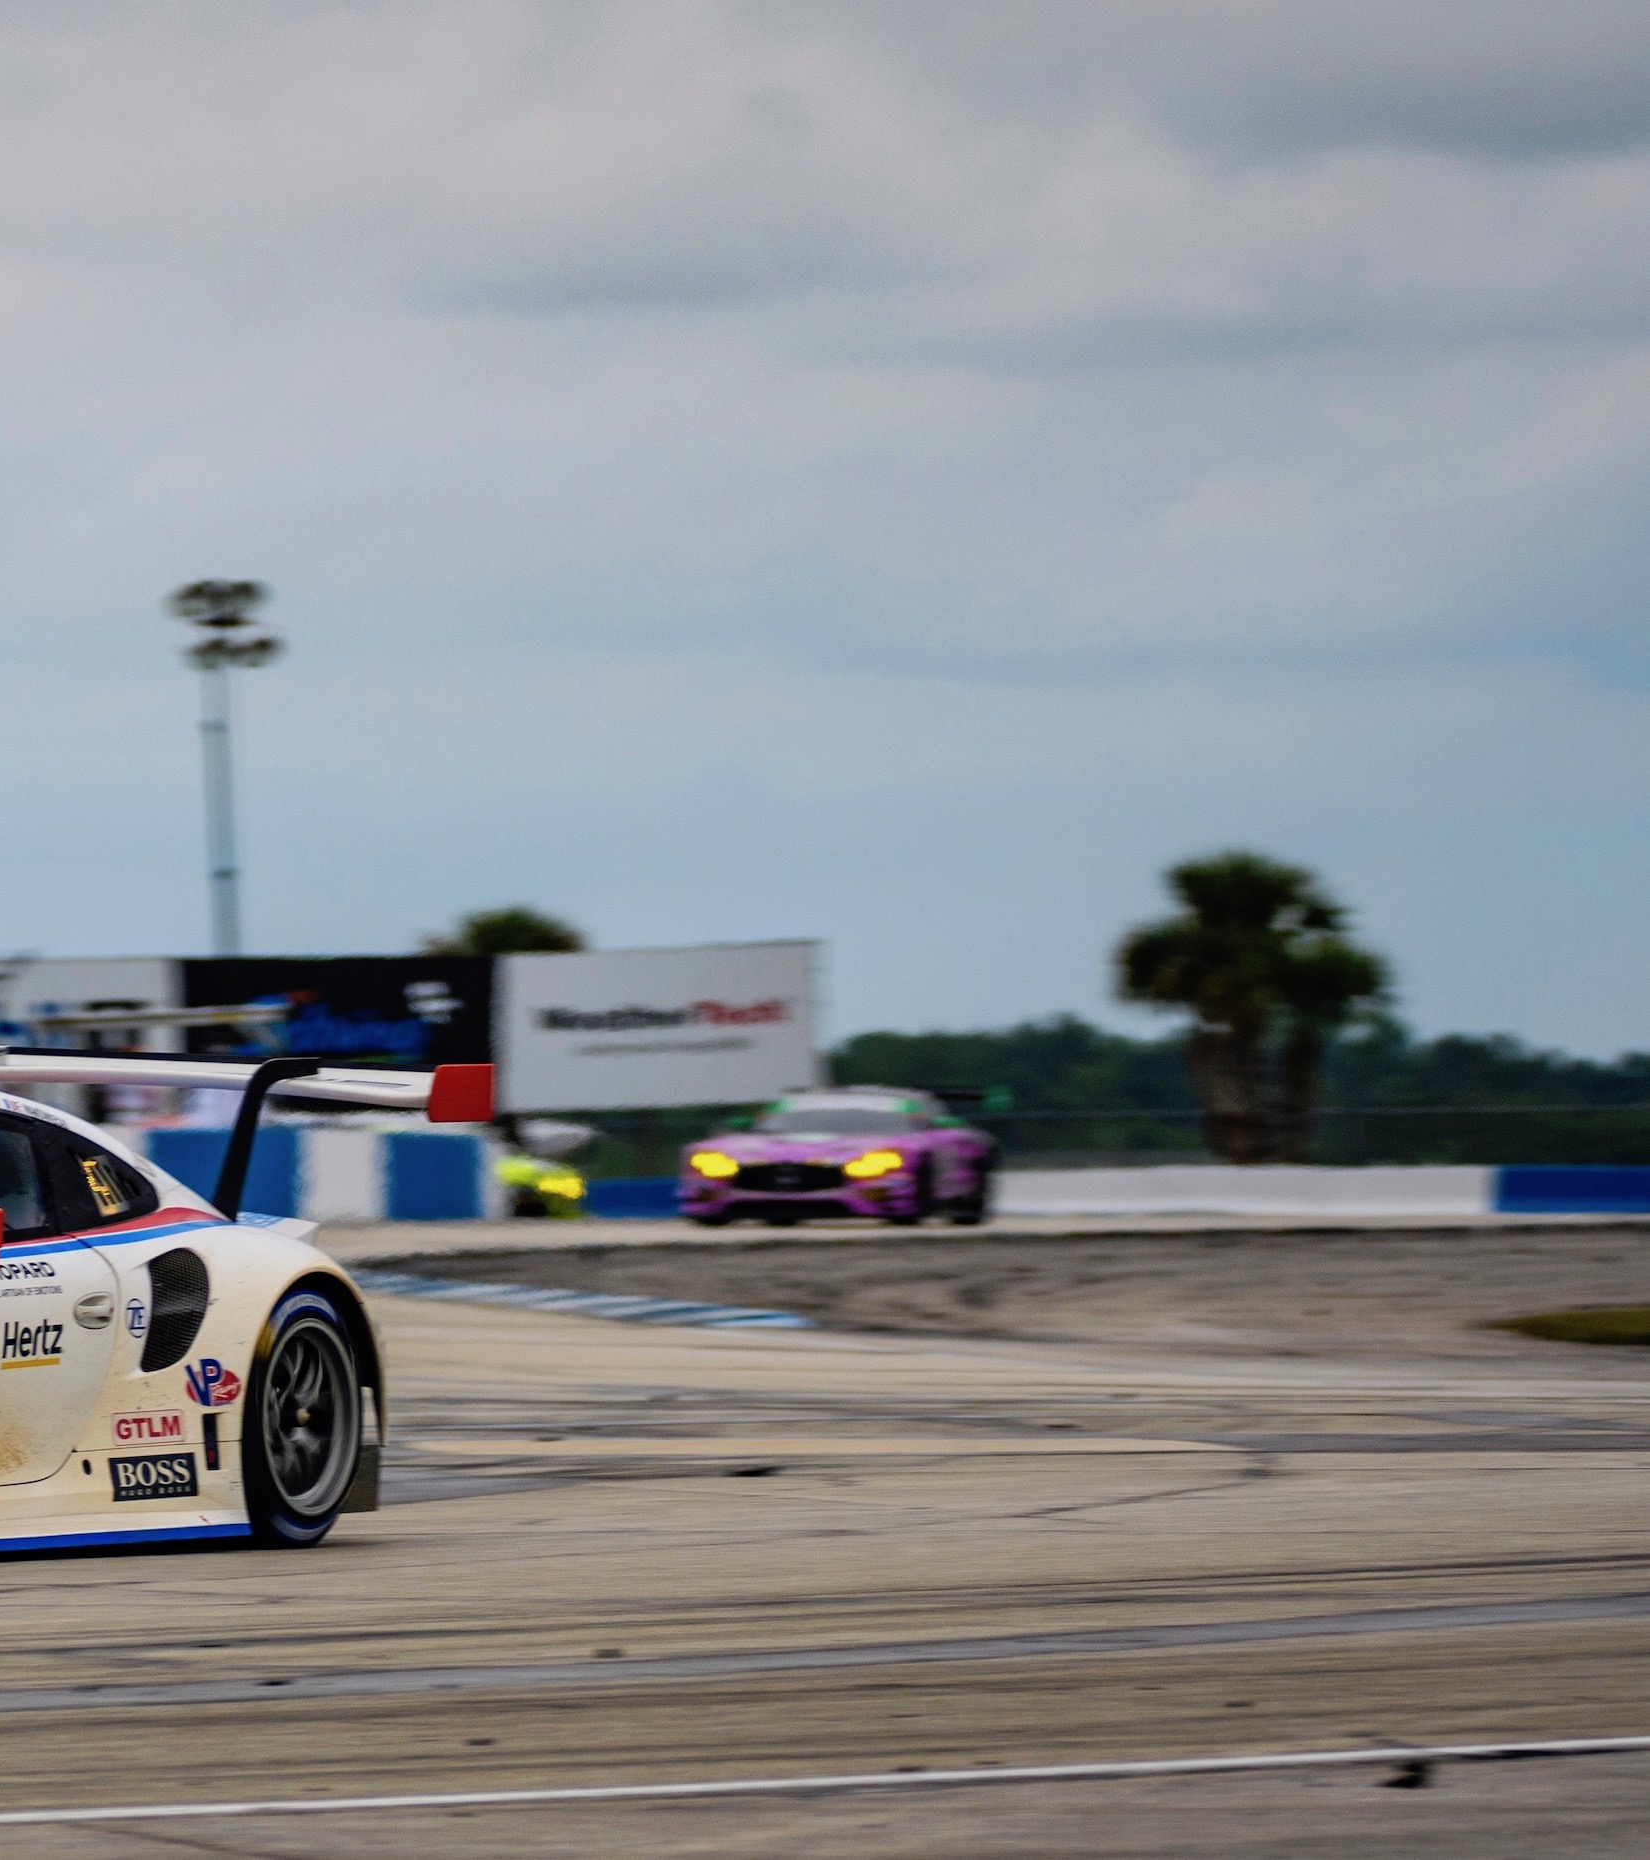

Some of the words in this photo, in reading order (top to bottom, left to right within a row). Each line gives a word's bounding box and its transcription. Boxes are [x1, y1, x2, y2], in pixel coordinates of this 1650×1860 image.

[2, 1319, 64, 1359] Hertz
[184, 1358, 223, 1406] VP
[116, 1415, 181, 1440] GTLM
[116, 1458, 191, 1488] BOSS
[120, 1487, 153, 1498] HUGO
[159, 1484, 192, 1495] BOSS
